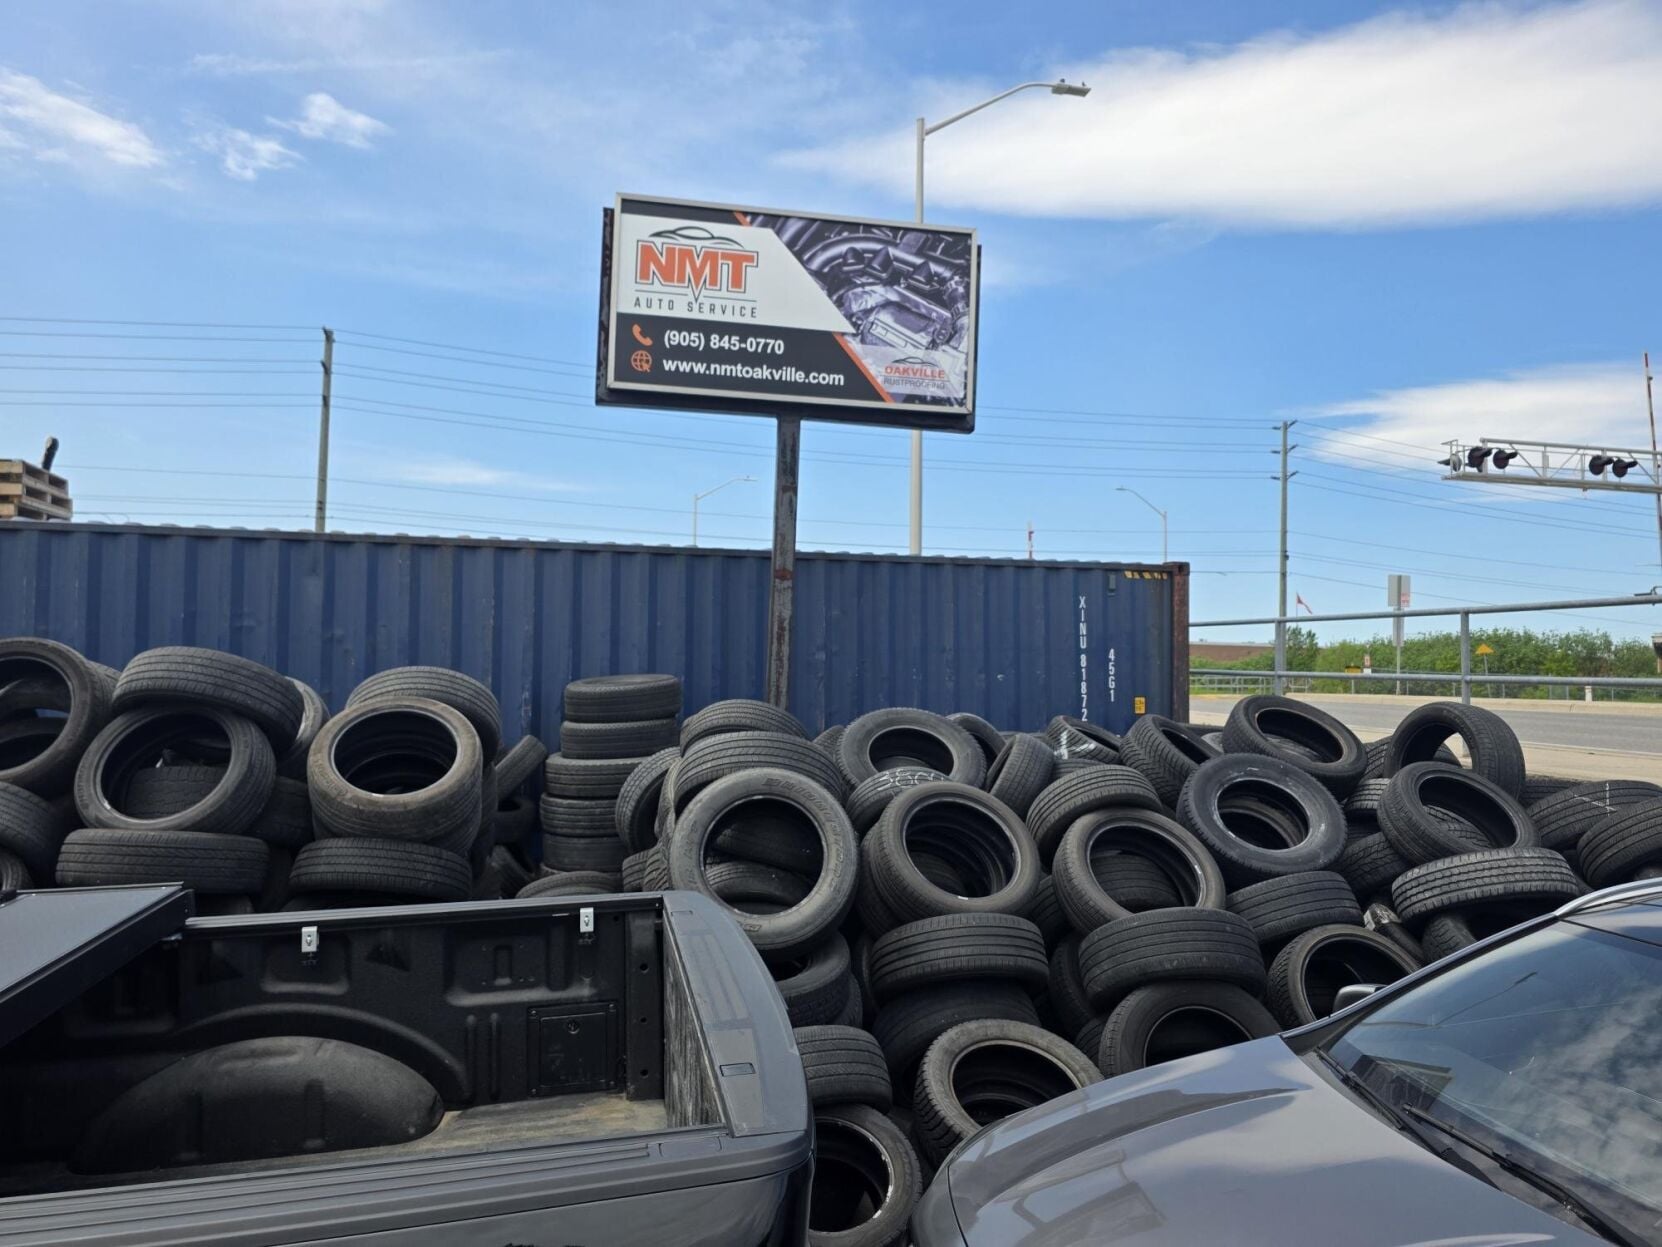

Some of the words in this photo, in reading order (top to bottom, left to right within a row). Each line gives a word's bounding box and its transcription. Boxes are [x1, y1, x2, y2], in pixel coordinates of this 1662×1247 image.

[635, 240, 759, 301] NMT
[634, 297, 674, 311] AUTO
[687, 302, 757, 318] SERVICE
[664, 330, 705, 351] (905)
[710, 334, 785, 355] 845-0770
[663, 359, 844, 386] www.nmtoakville.com
[883, 377, 945, 390] RUSTPROOFING
[885, 366, 945, 379] OAKVILLE
[1079, 596, 1087, 649] XINU
[1080, 654, 1088, 722] 81872
[1108, 648, 1116, 702] 45G1
